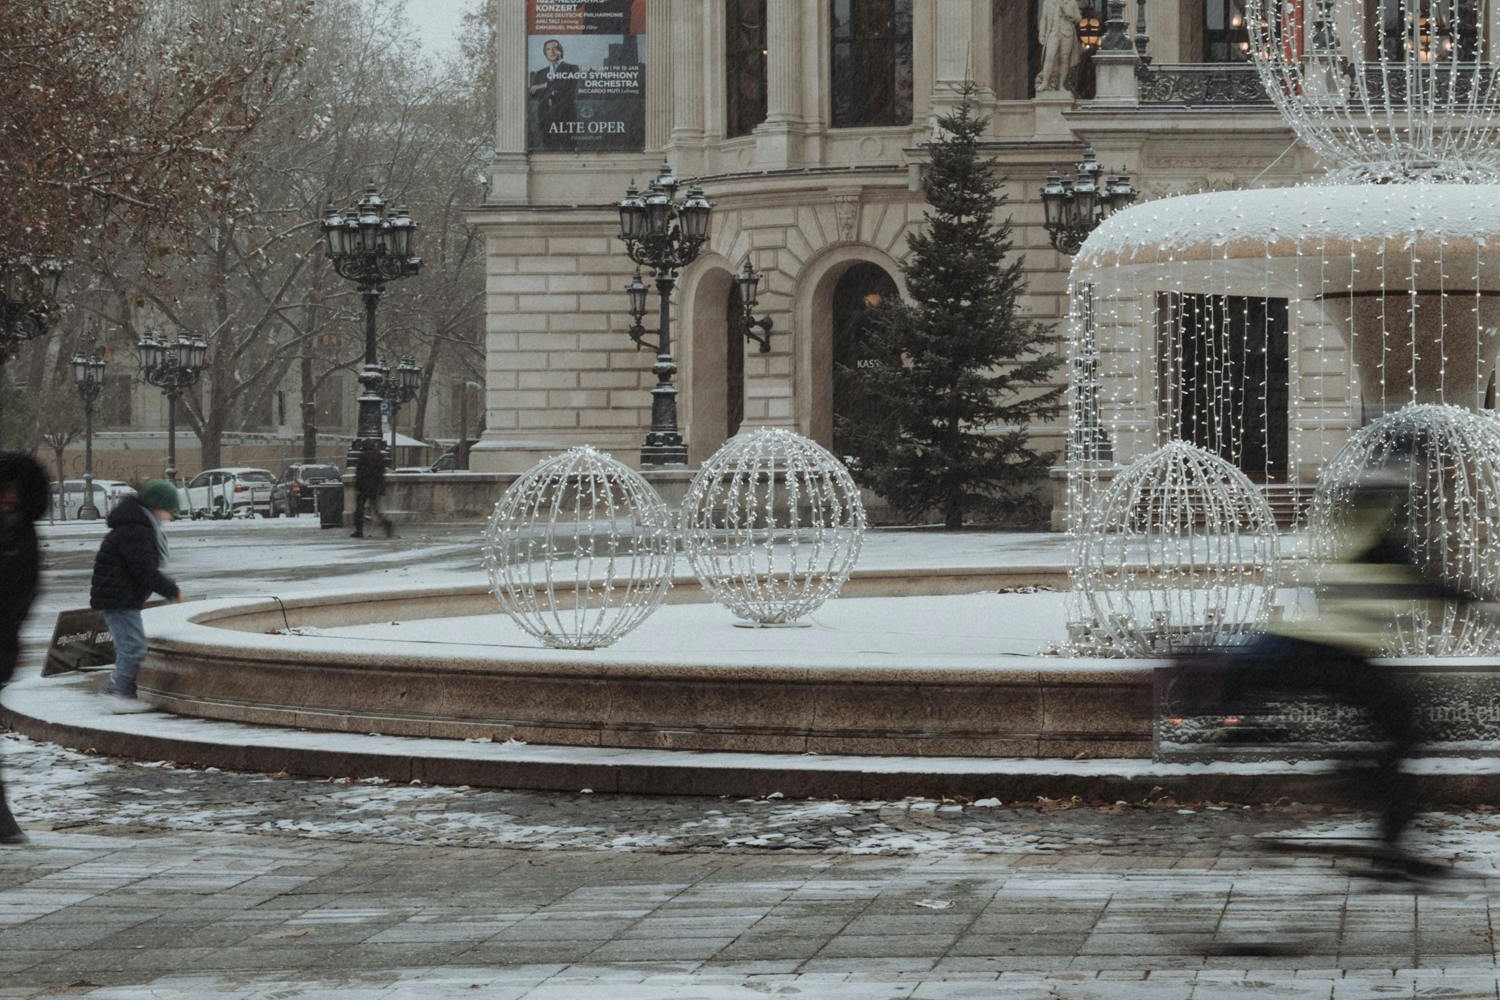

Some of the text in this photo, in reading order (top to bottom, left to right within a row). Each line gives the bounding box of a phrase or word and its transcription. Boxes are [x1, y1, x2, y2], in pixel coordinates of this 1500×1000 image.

[536, 4, 577, 12] KONZERT
[546, 72, 587, 80] CHICAGO
[584, 80, 639, 88] ORCHESTRA
[548, 121, 625, 133] ALTE OPER
